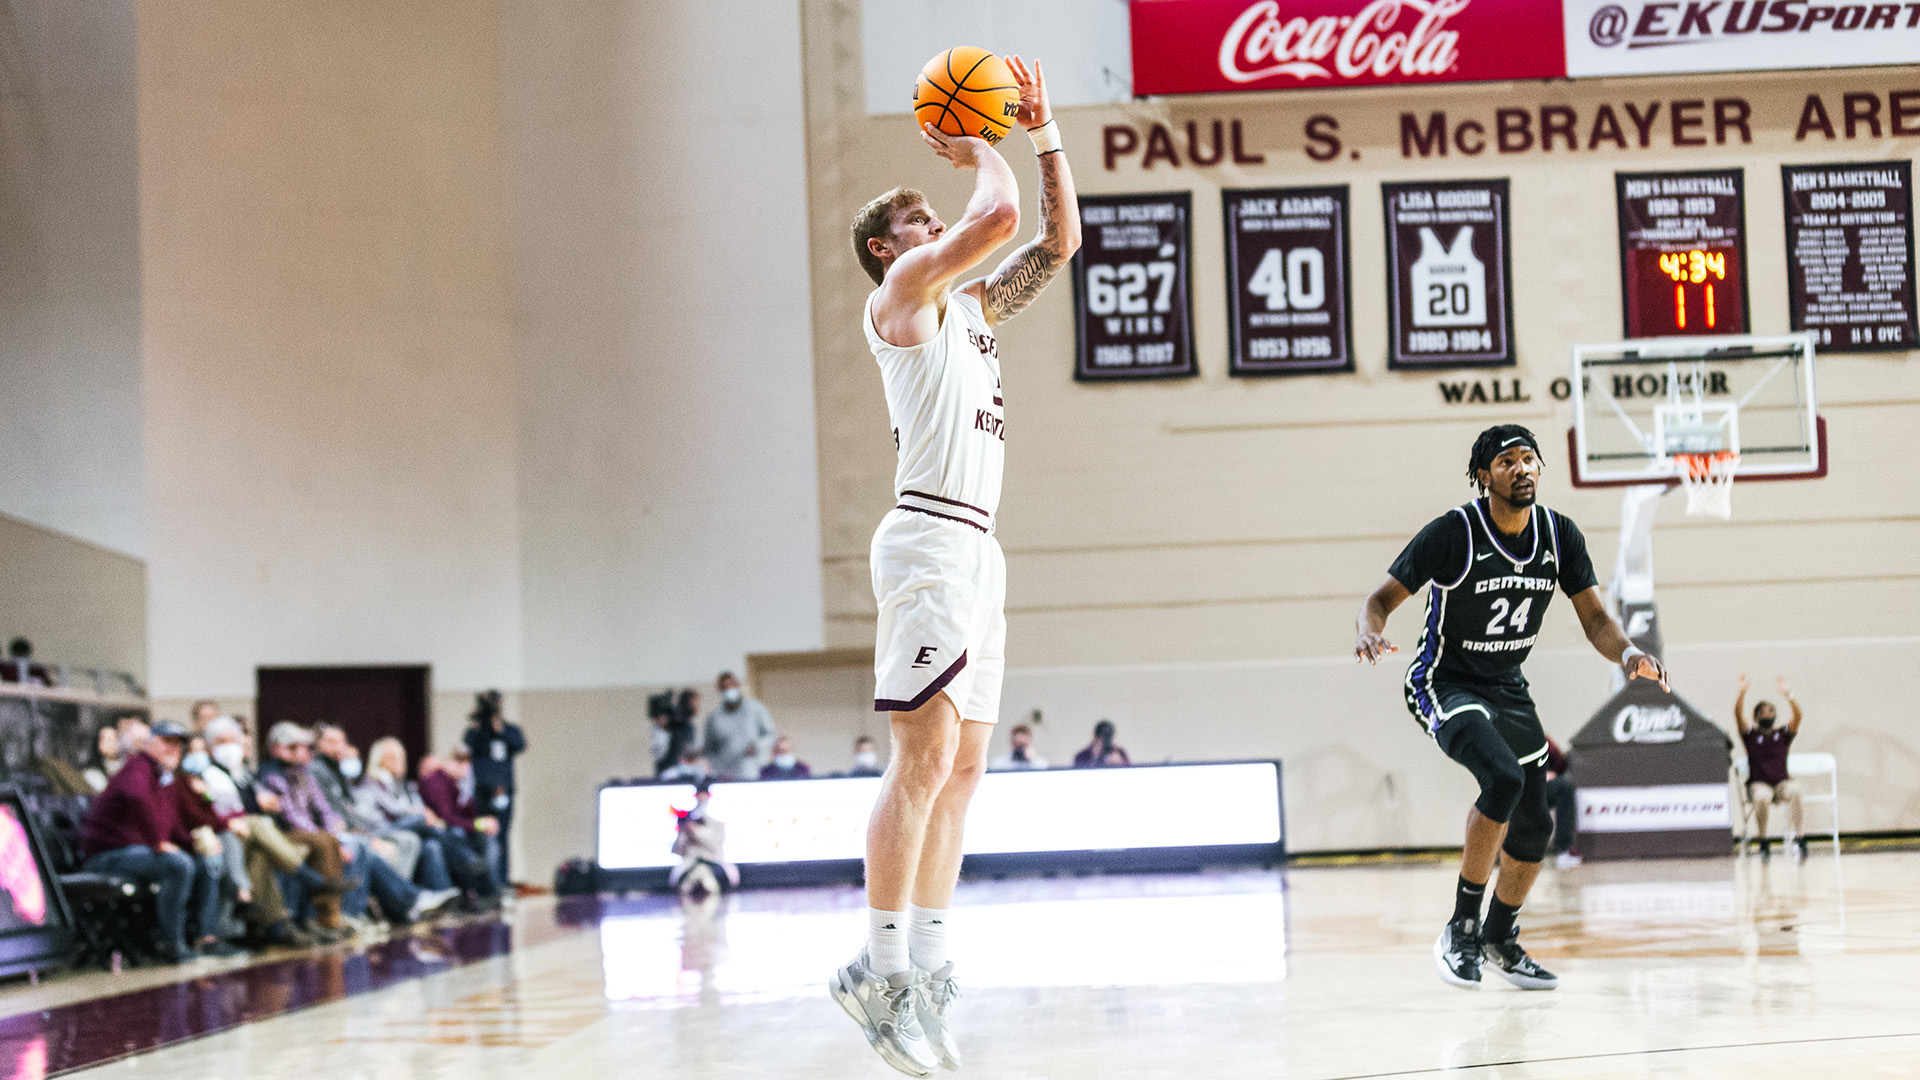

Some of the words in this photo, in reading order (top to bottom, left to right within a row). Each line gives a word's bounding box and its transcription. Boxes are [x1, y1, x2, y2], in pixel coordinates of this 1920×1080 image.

[1218, 0, 1471, 83] Coca-Cola
[1102, 118, 1266, 171] PAUL
[1304, 114, 1361, 162] S.
[1399, 98, 1753, 159] McBRAYER
[1662, 177, 1737, 196] BASKETBALL
[1792, 172, 1827, 192] MEN'S
[1828, 170, 1903, 188] BASKETBALL
[988, 250, 1048, 313] Family
[1248, 247, 1325, 311] 40
[1659, 249, 1725, 284] 4:34
[1087, 261, 1176, 316] 627
[1429, 283, 1470, 316] 20
[1674, 282, 1716, 330] 11
[1439, 378, 1531, 403] WALL
[1475, 576, 1554, 594] CENTRAL
[1486, 597, 1533, 636] 24
[914, 646, 938, 665] E
